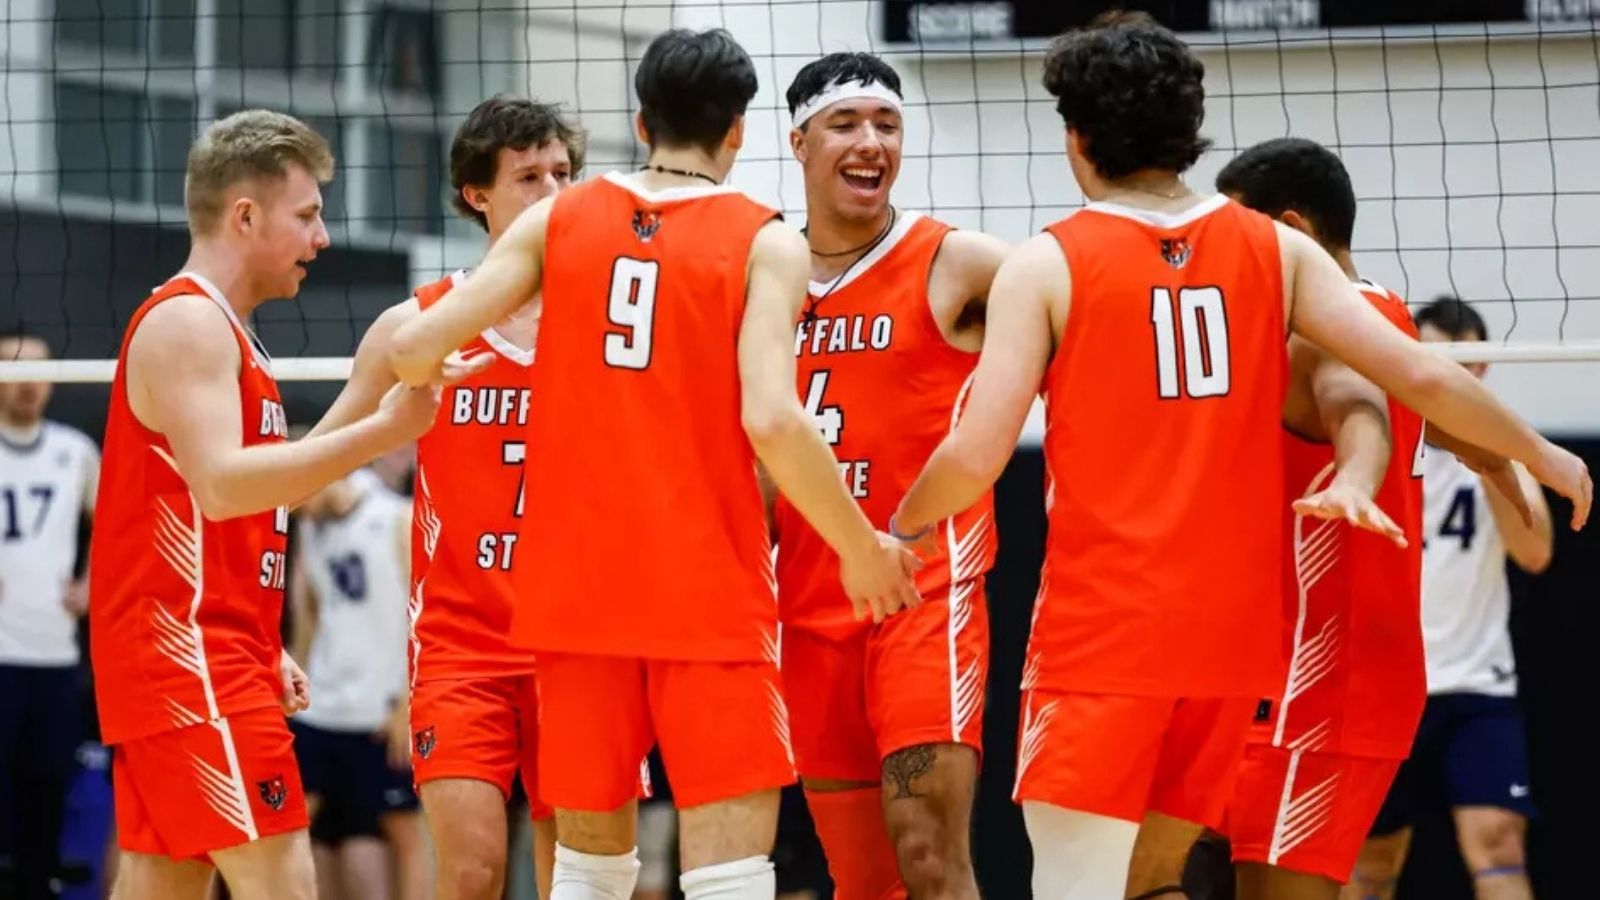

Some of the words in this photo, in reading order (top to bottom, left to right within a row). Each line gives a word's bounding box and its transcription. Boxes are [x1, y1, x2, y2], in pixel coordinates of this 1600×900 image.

[603, 255, 660, 371] 9
[1149, 284, 1231, 399] 10
[451, 386, 531, 426] BUFF
[804, 369, 844, 444] 4
[1, 486, 54, 540] 17
[1421, 487, 1477, 551] 4
[476, 532, 518, 572] ST
